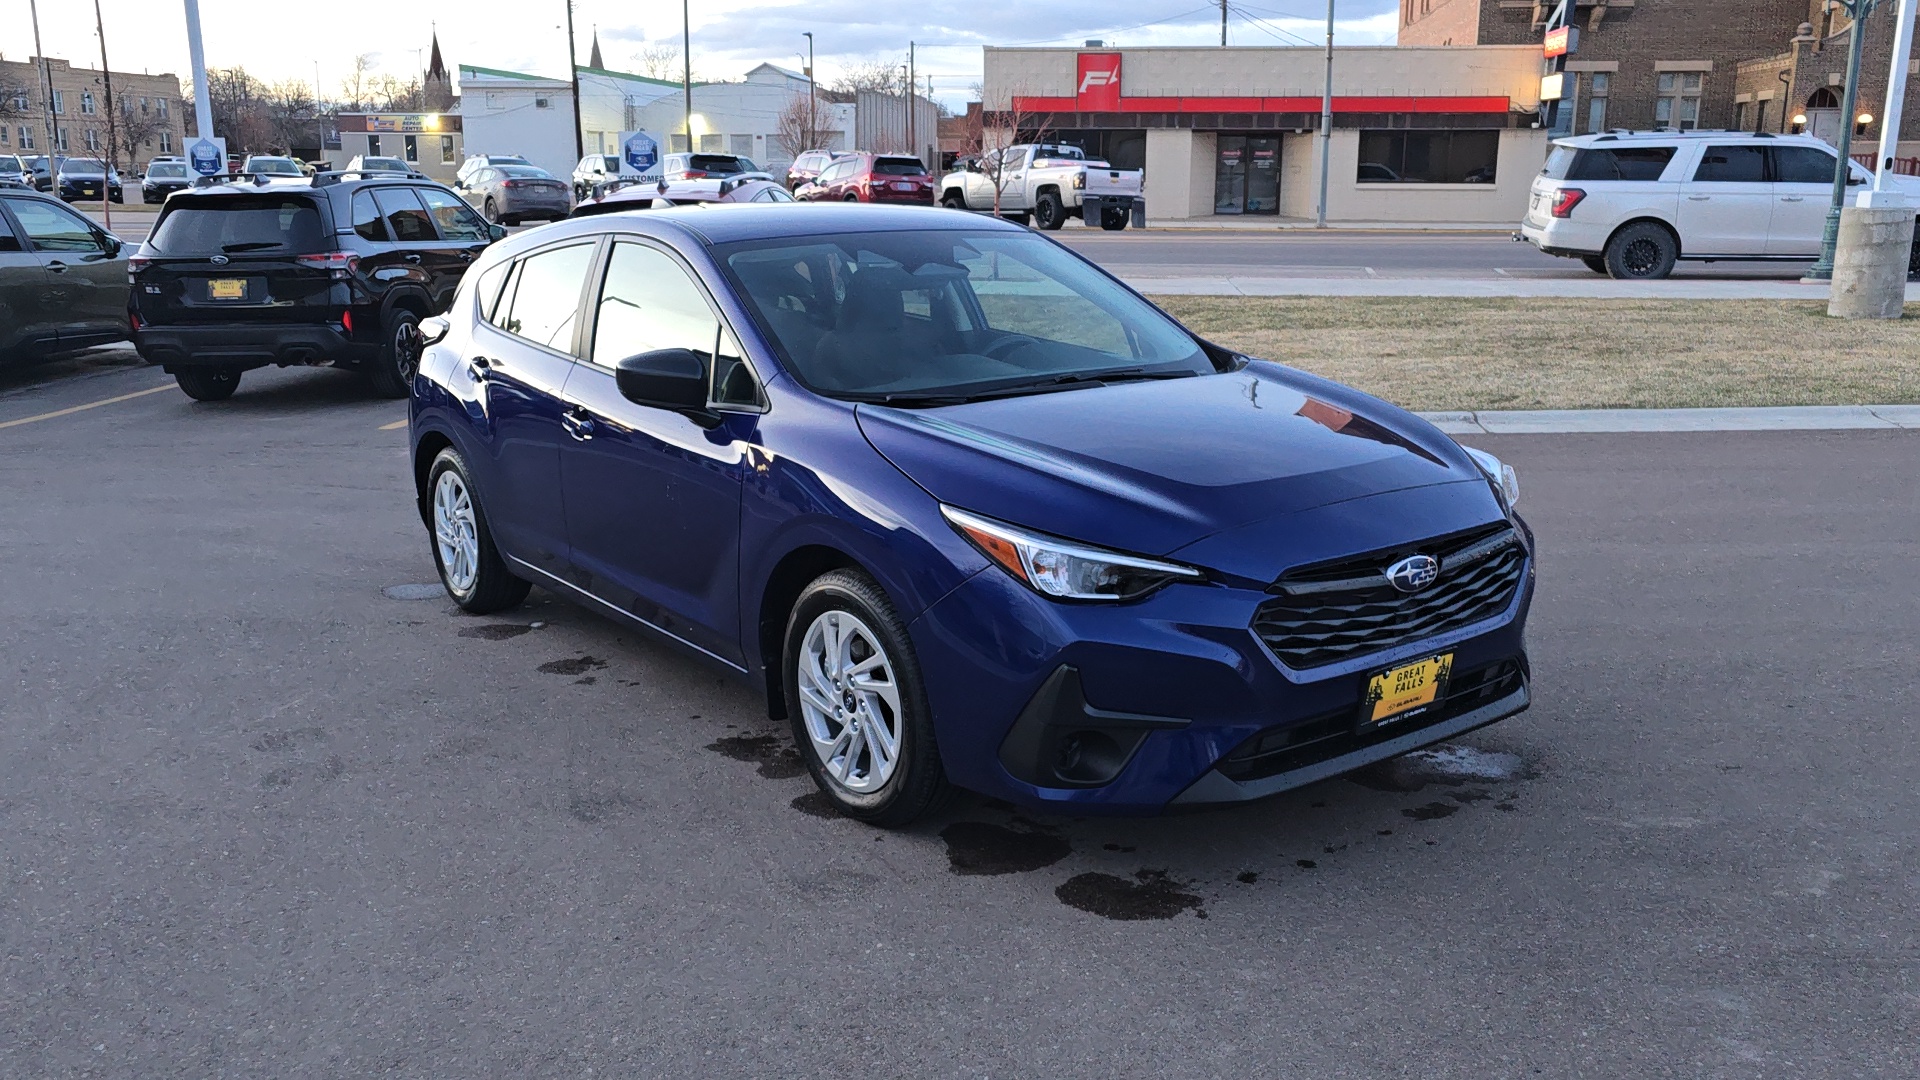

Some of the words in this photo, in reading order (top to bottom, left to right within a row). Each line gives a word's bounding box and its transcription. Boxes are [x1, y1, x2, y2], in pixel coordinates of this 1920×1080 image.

[618, 174, 666, 183] CUSTOMER
[1397, 665, 1426, 683] GREAT
[1395, 676, 1424, 694] FALLS
